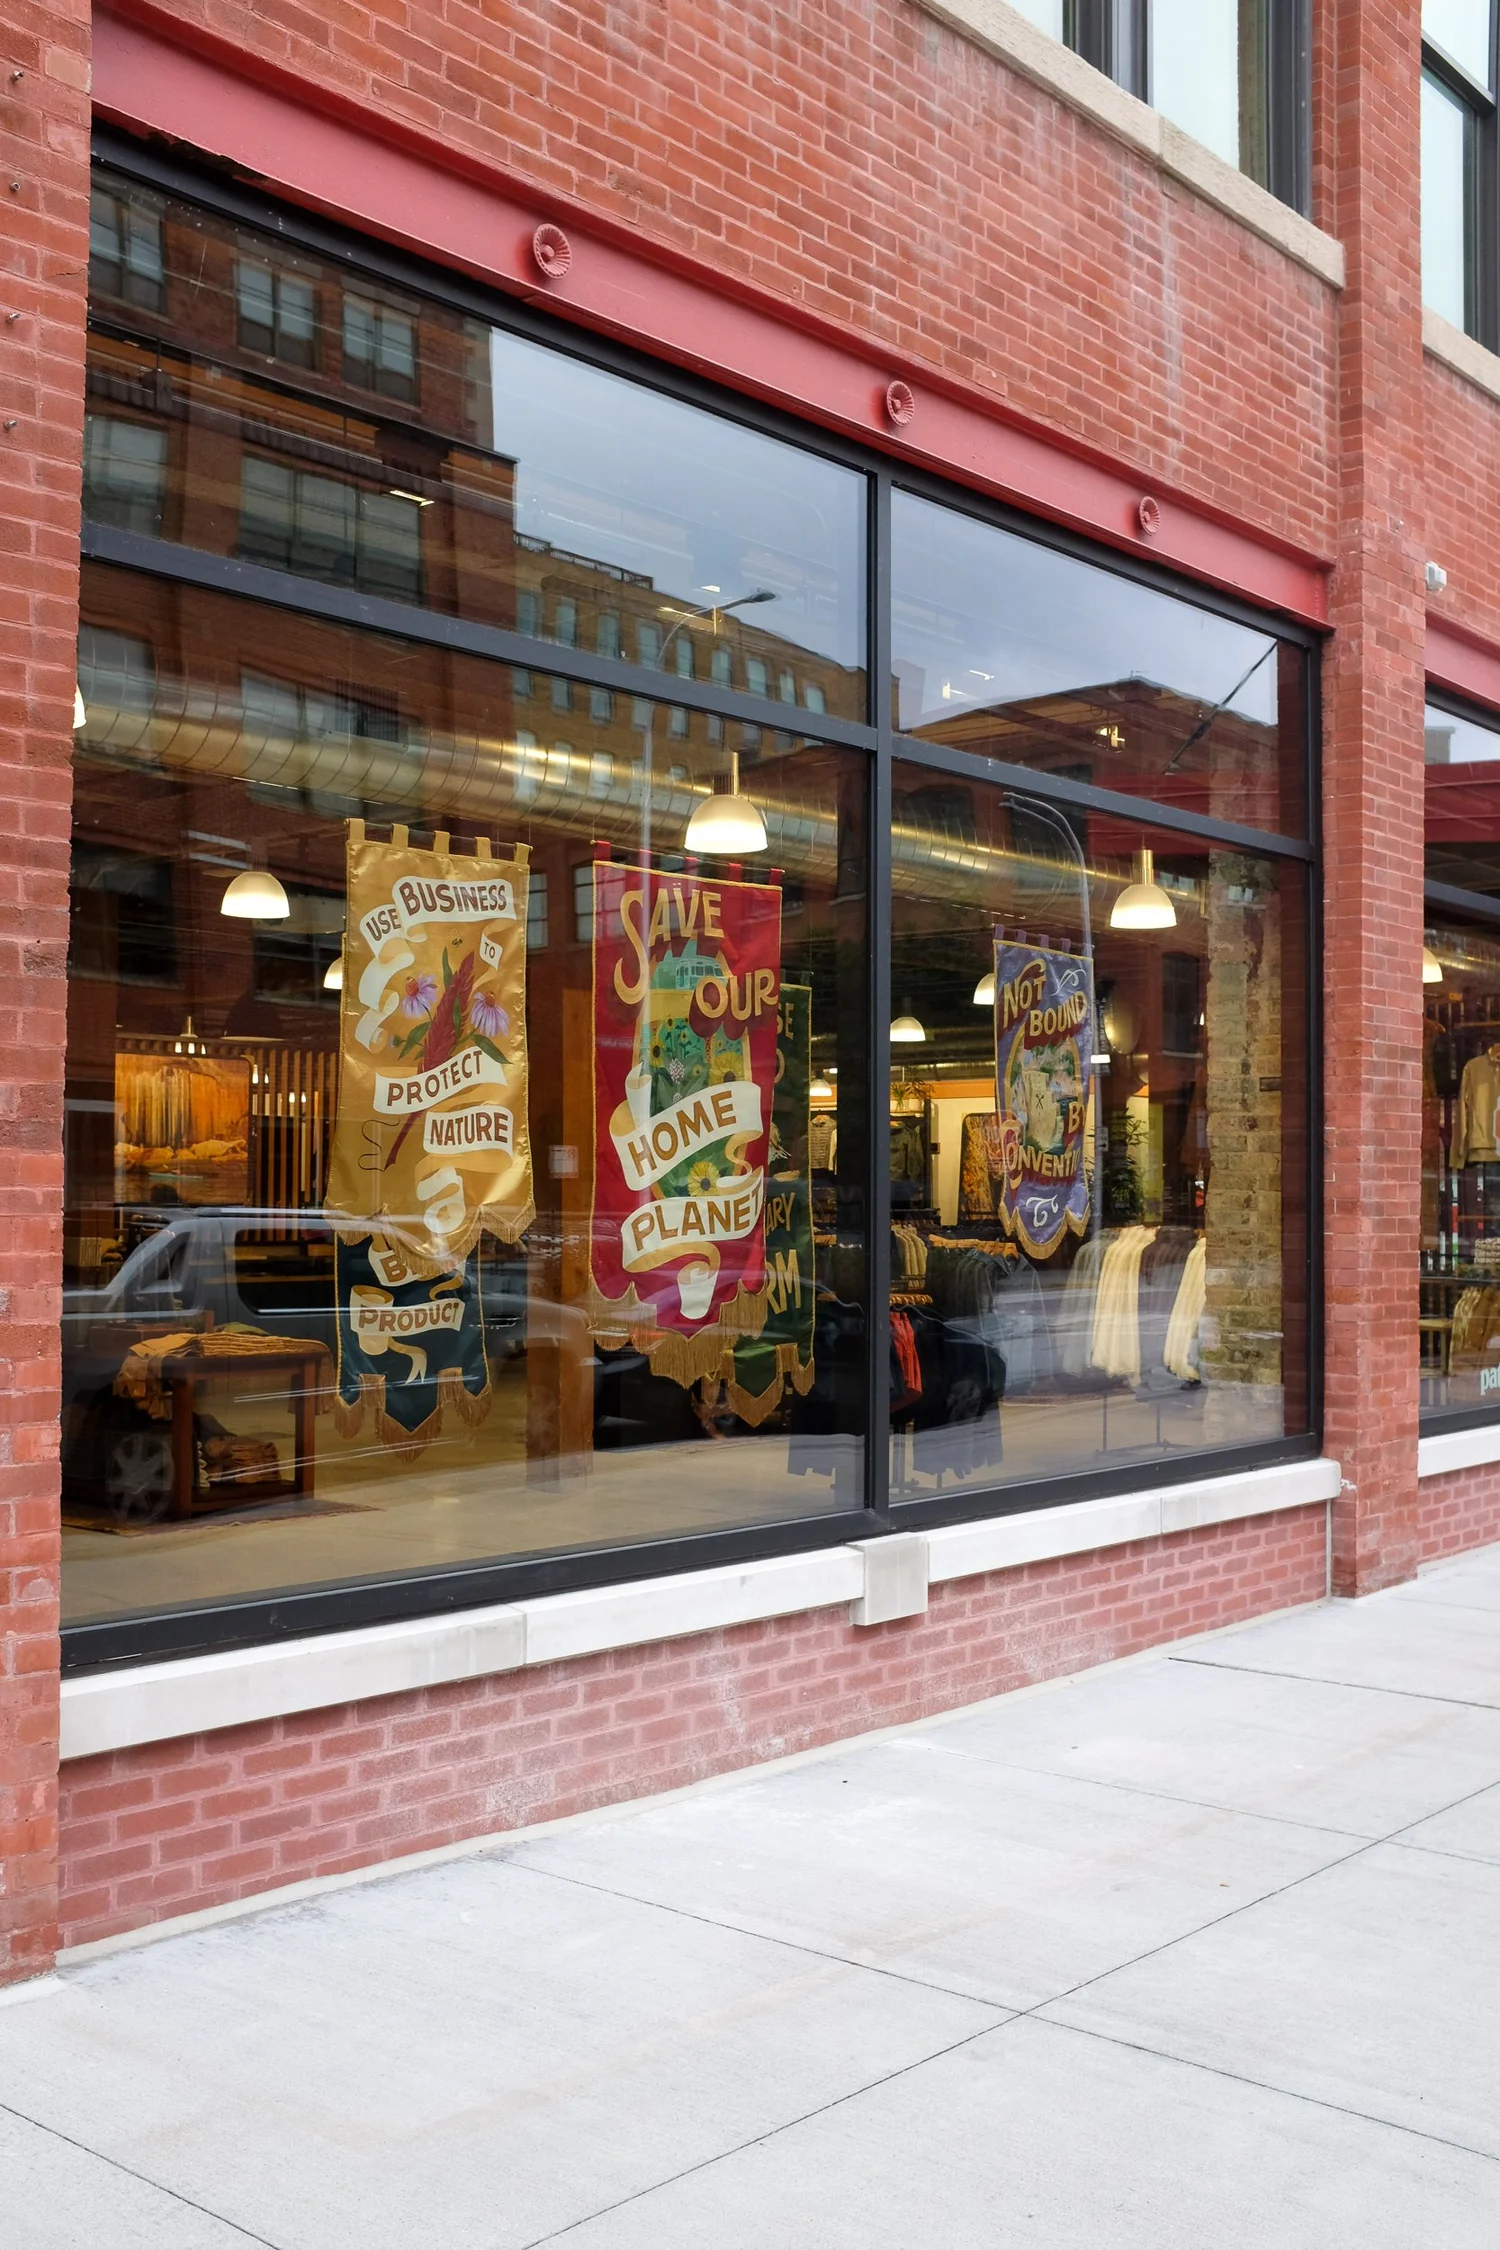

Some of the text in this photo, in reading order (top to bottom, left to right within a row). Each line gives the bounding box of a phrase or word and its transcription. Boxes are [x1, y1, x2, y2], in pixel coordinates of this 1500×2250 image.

[366, 881, 507, 941] USE BUSINESS
[484, 942, 496, 959] TO
[613, 887, 725, 1005] SAVE
[695, 968, 779, 1021] OUR
[1004, 958, 1047, 1028] NOT
[1029, 991, 1087, 1036] BOUND
[387, 1050, 483, 1107] PROTECT
[430, 1111, 509, 1147] NATURE
[627, 1090, 737, 1177] HOME
[631, 1184, 764, 1252] PLANET
[358, 1302, 461, 1332] PRODUCT
